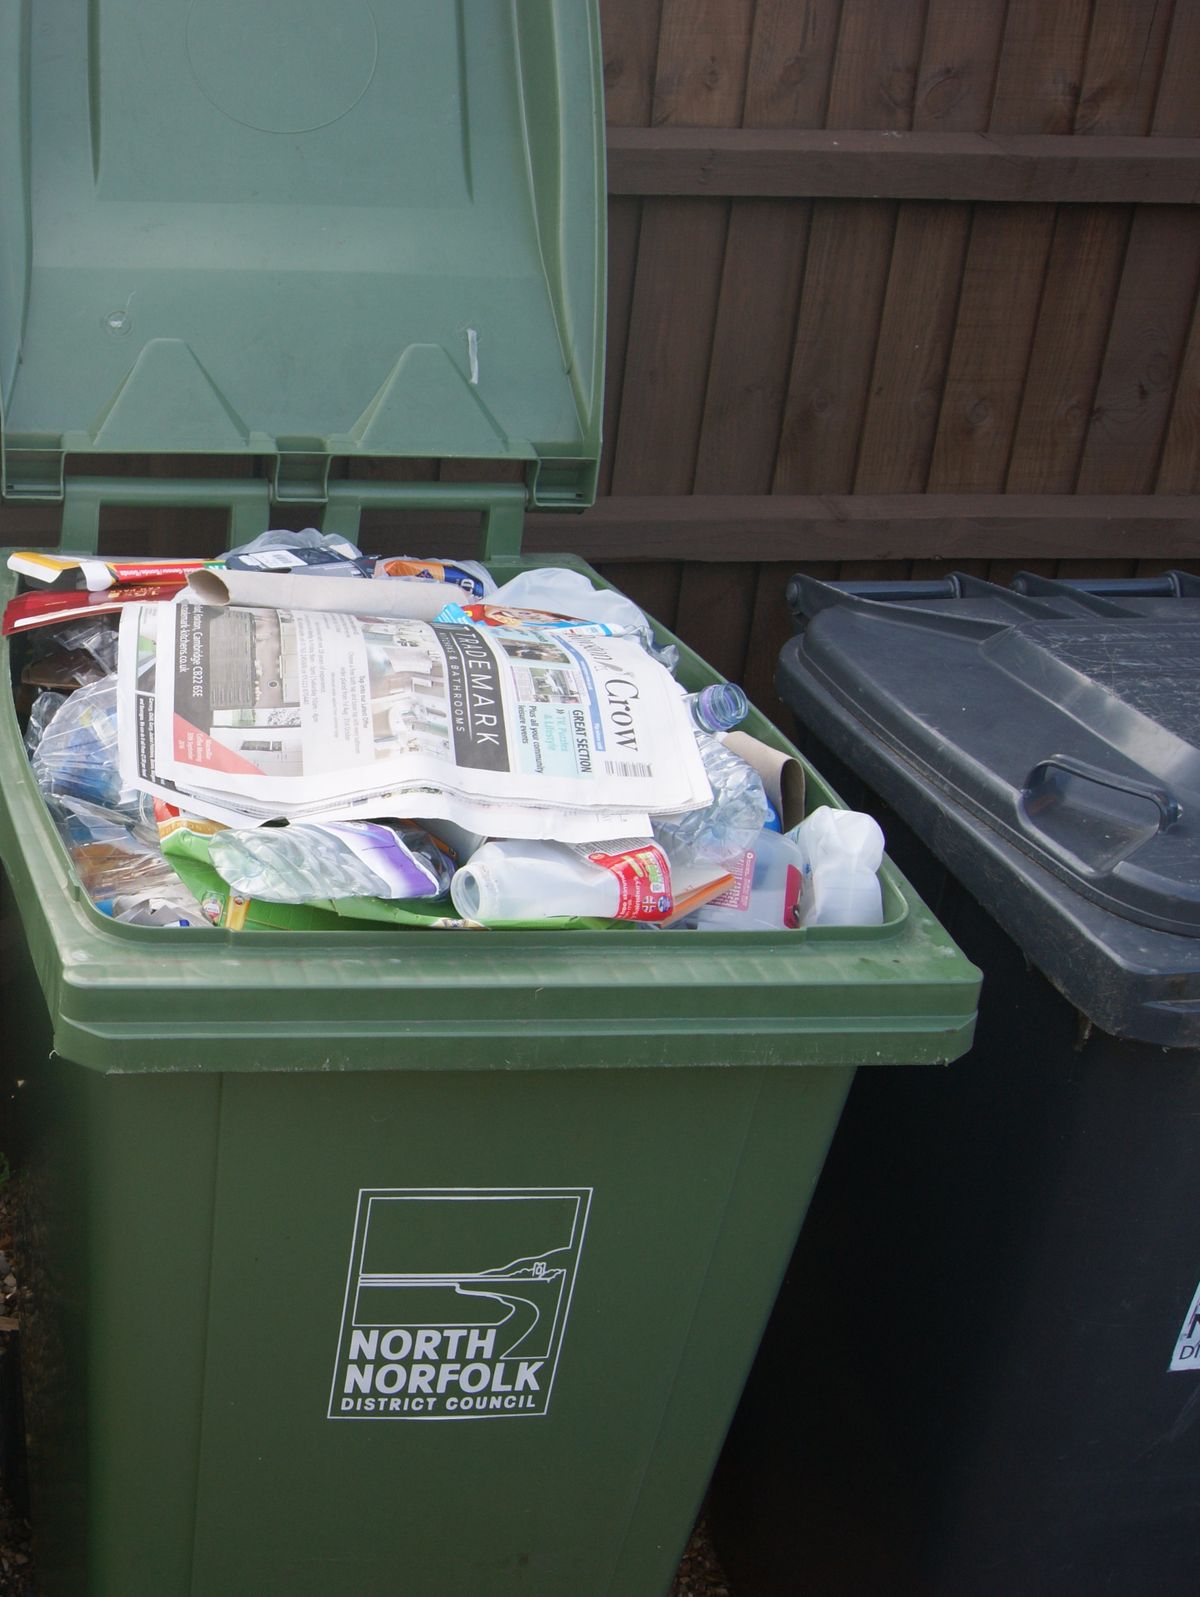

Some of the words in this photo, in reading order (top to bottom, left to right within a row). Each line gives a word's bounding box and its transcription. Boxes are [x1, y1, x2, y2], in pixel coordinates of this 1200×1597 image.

[191, 631, 204, 665] Cambridge
[191, 666, 204, 686] CB22
[455, 632, 500, 746] TRADEMARK
[191, 686, 204, 698] 6SE
[450, 664, 465, 732] BATHROOMS
[518, 704, 526, 725] leisure
[529, 705, 537, 718] Plus
[530, 719, 539, 727] all
[572, 709, 587, 737] GREAT
[604, 679, 641, 752] Crow
[520, 725, 529, 745] events
[530, 727, 539, 741] your
[533, 741, 544, 774] community
[576, 738, 592, 773] SECTION
[349, 1329, 496, 1360] NORTH
[343, 1361, 545, 1394] NORFOLK
[341, 1397, 437, 1411] DISTRICT
[445, 1395, 536, 1410] COUNCIL
